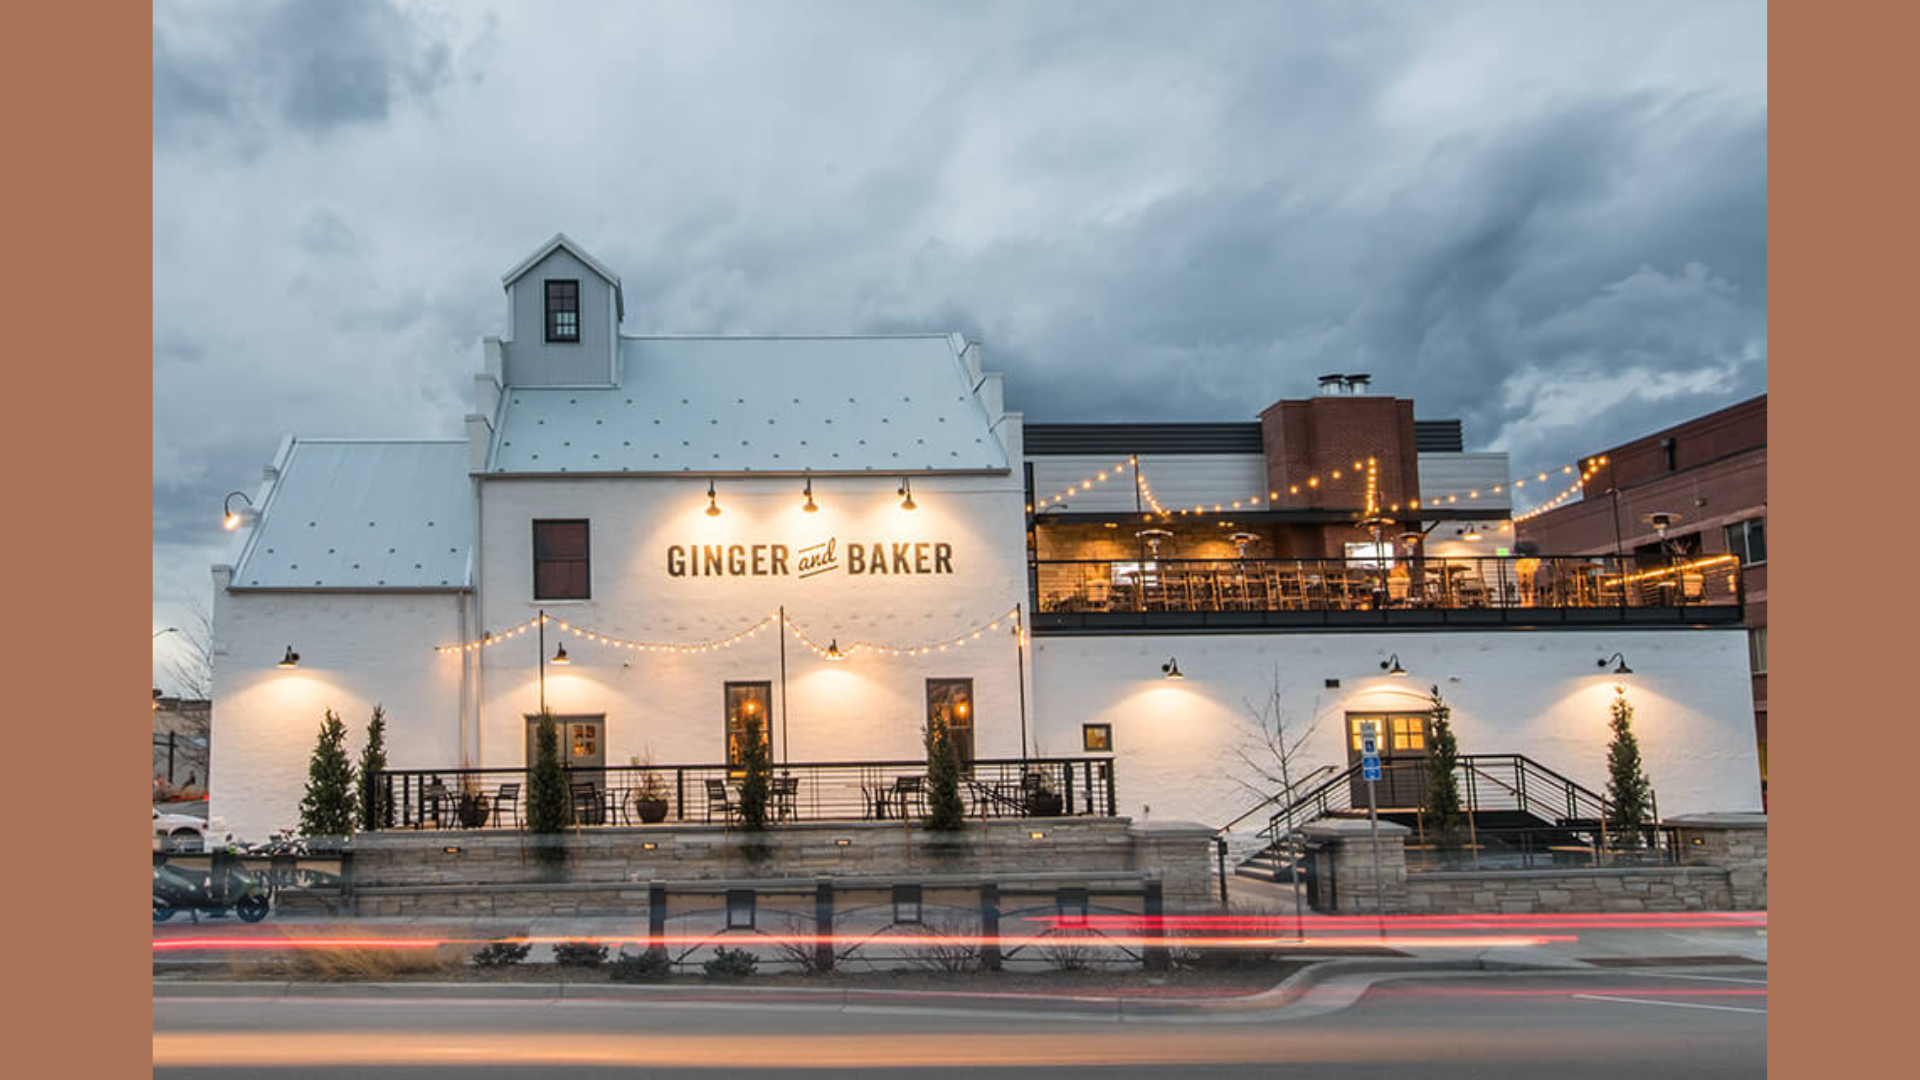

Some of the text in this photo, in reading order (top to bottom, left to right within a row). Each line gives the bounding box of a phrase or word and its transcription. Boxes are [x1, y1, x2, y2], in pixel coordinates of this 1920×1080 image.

[667, 537, 954, 577] GINGER and BAKER
